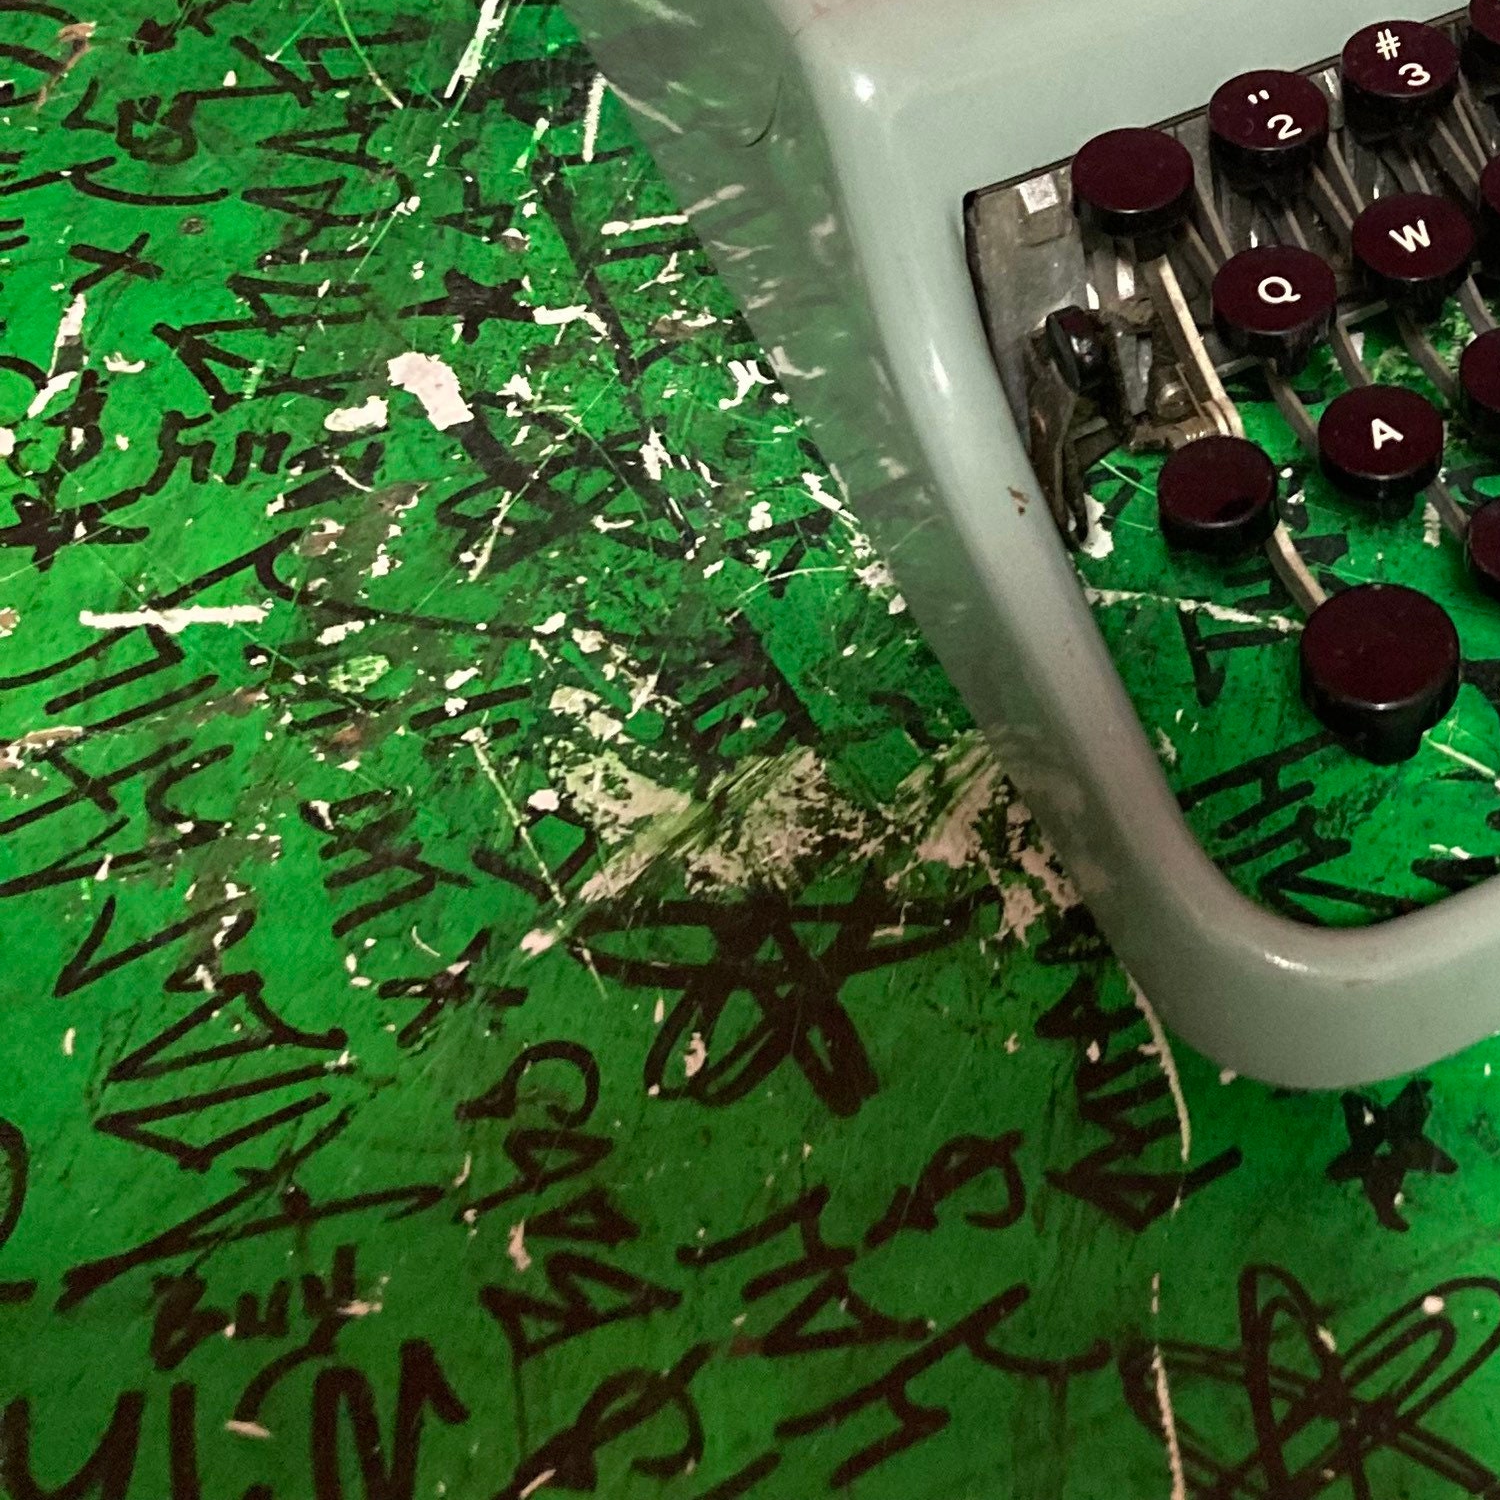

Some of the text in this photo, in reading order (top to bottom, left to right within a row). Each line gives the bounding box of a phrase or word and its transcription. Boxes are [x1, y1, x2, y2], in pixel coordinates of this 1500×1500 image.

[1375, 28, 1402, 61] #
[1398, 62, 1431, 87] 3
[1267, 114, 1303, 140] 2
[1388, 219, 1431, 253] W
[1257, 276, 1301, 304] Q
[1371, 418, 1404, 450] A
